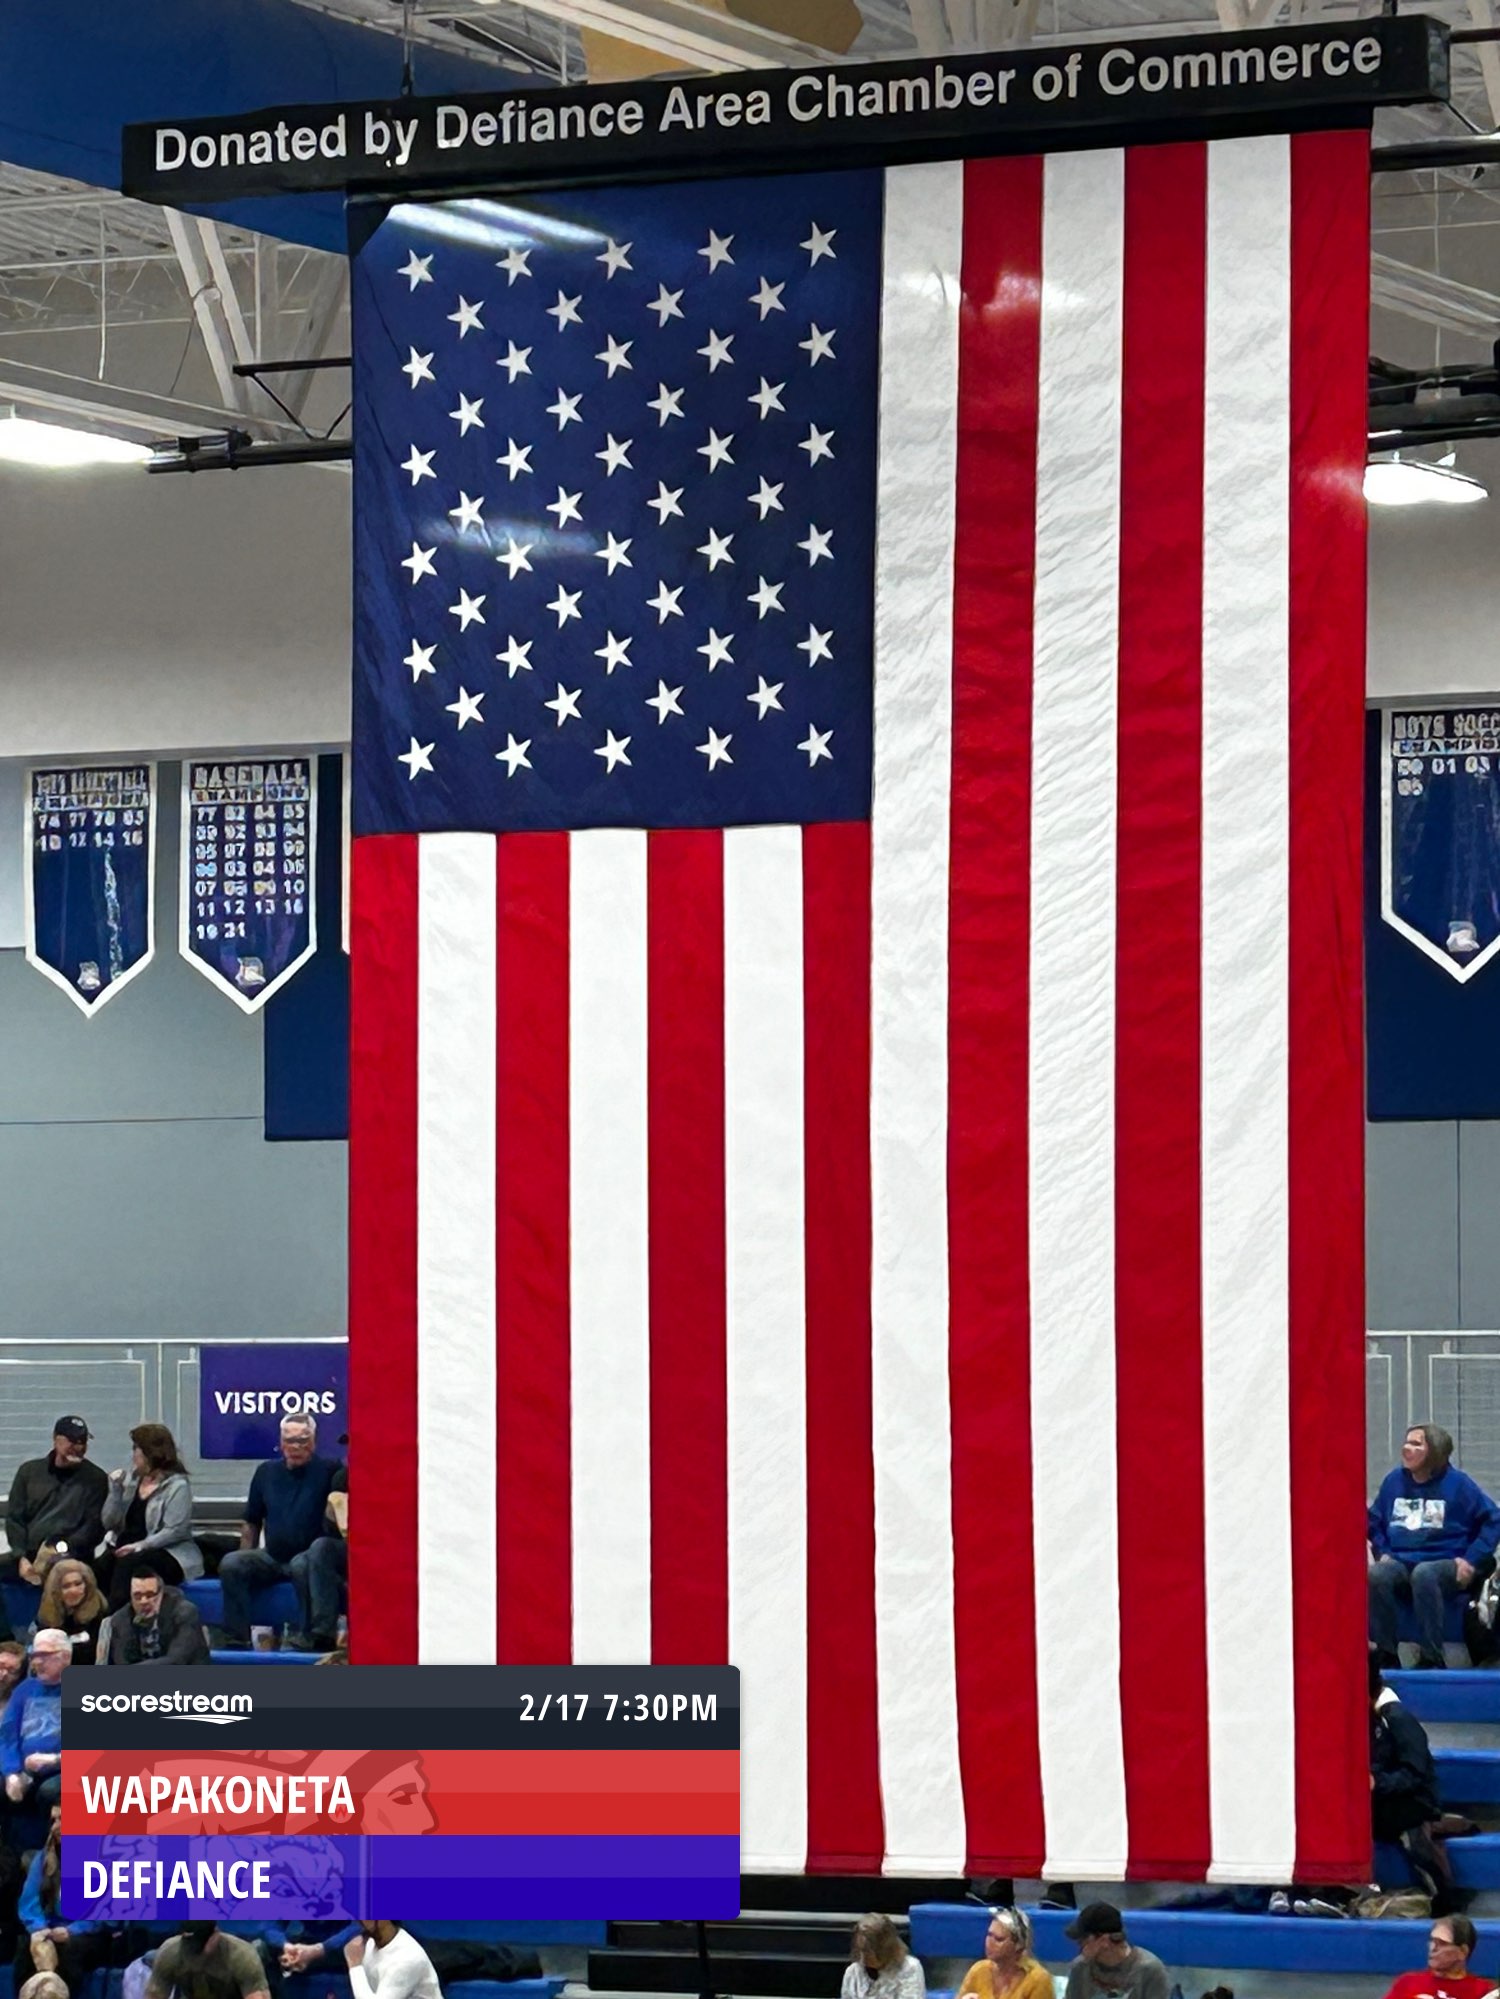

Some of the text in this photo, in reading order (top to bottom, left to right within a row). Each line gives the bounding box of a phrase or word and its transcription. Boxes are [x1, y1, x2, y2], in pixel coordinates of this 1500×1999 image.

[155, 35, 1382, 171] Donated by Defiance Area Chamber of Commerce
[194, 763, 307, 788] BASEBALL
[1432, 758, 1456, 775] 01
[195, 880, 217, 897] 07
[284, 879, 305, 895] 10
[197, 902, 216, 917] 11
[223, 899, 246, 915] 12
[214, 1390, 336, 1415] VISITORS
